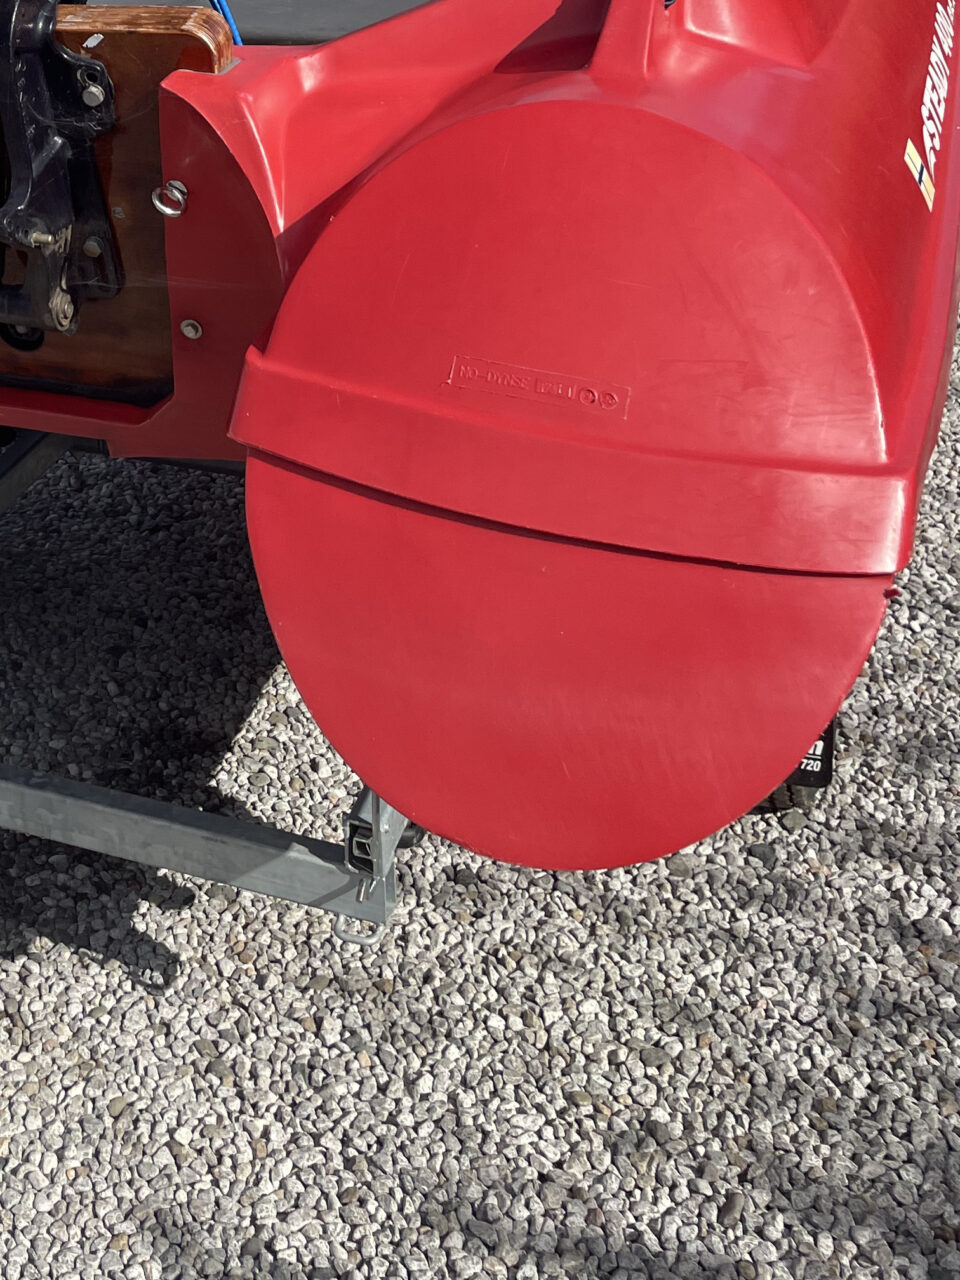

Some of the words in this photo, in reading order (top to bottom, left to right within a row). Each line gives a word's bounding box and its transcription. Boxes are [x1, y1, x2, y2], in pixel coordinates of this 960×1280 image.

[933, 1, 954, 57] 400
[921, 34, 950, 151] STEADY
[800, 759, 821, 772] 720
